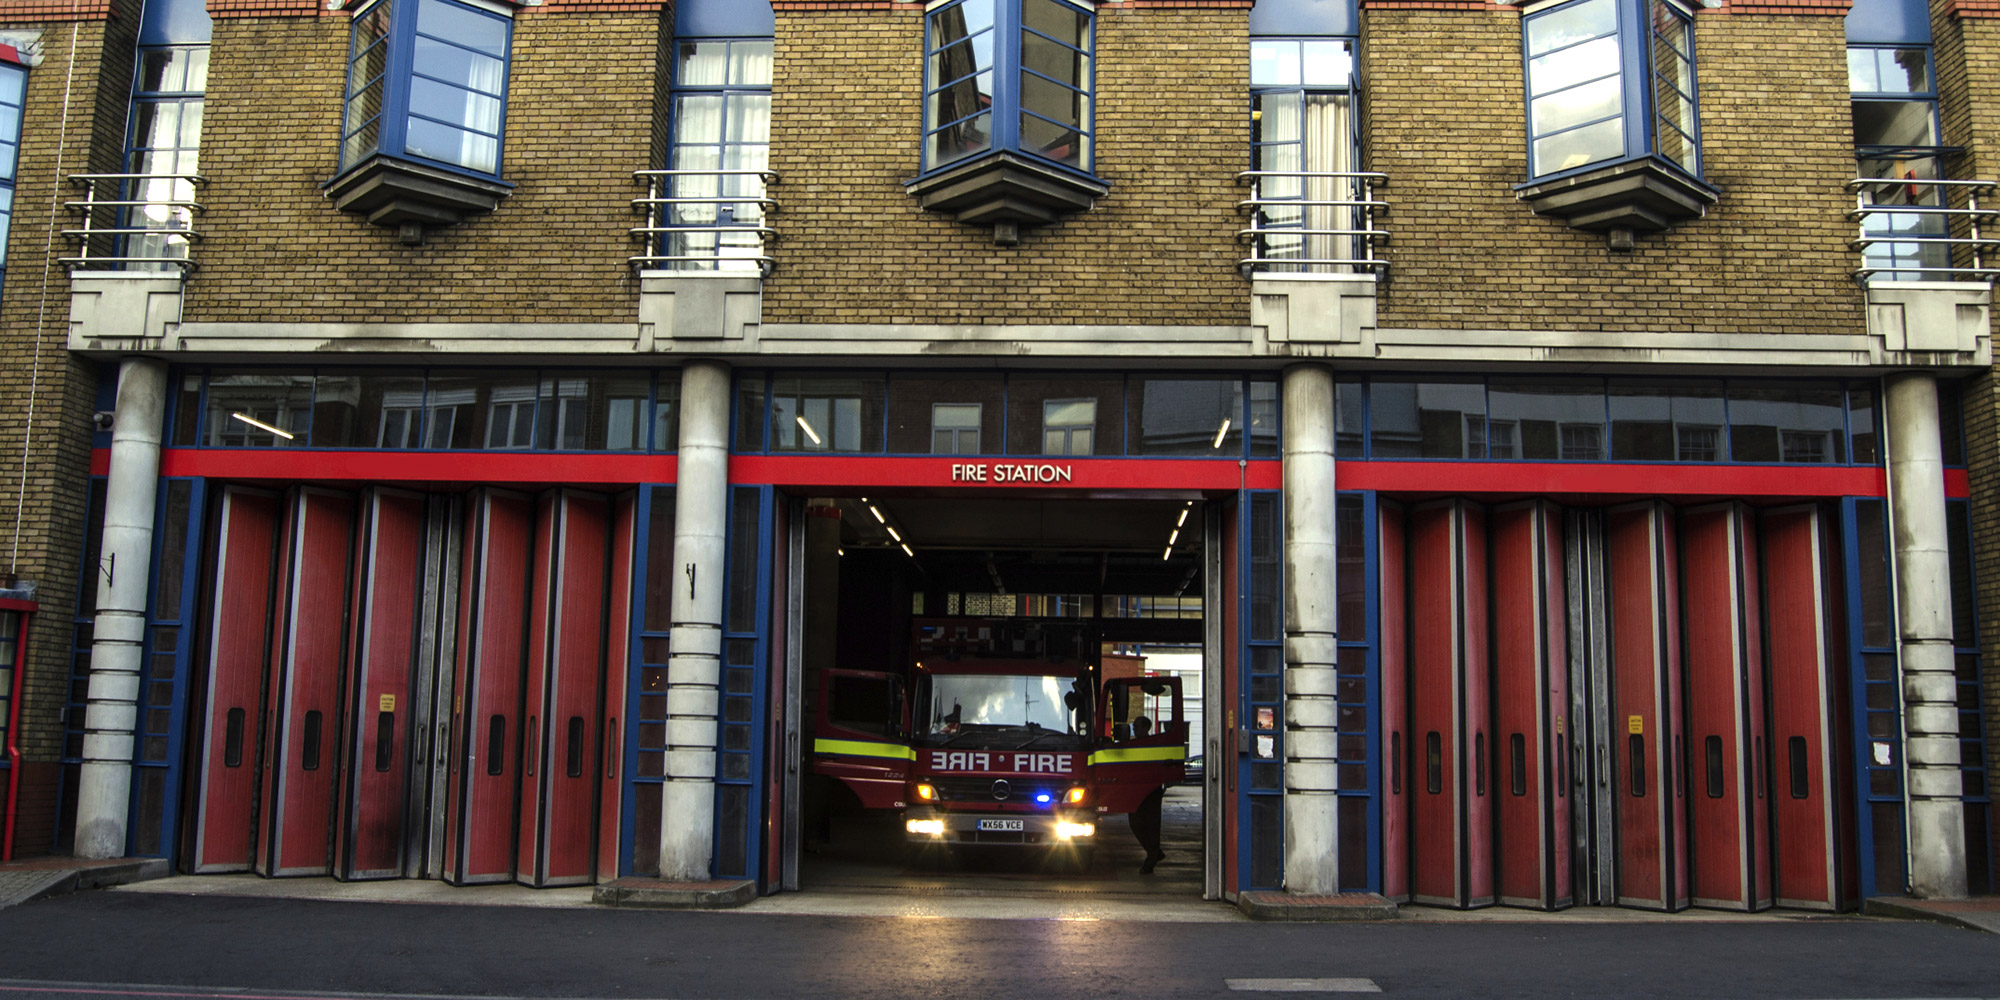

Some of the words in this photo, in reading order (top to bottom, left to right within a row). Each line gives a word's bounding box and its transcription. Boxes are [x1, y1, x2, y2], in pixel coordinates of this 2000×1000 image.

[952, 464, 987, 481] FIRE
[993, 464, 1072, 482] STATION
[1014, 753, 1073, 773] FIRE
[982, 820, 1004, 829] WX56
[1005, 820, 1022, 830] VCE
